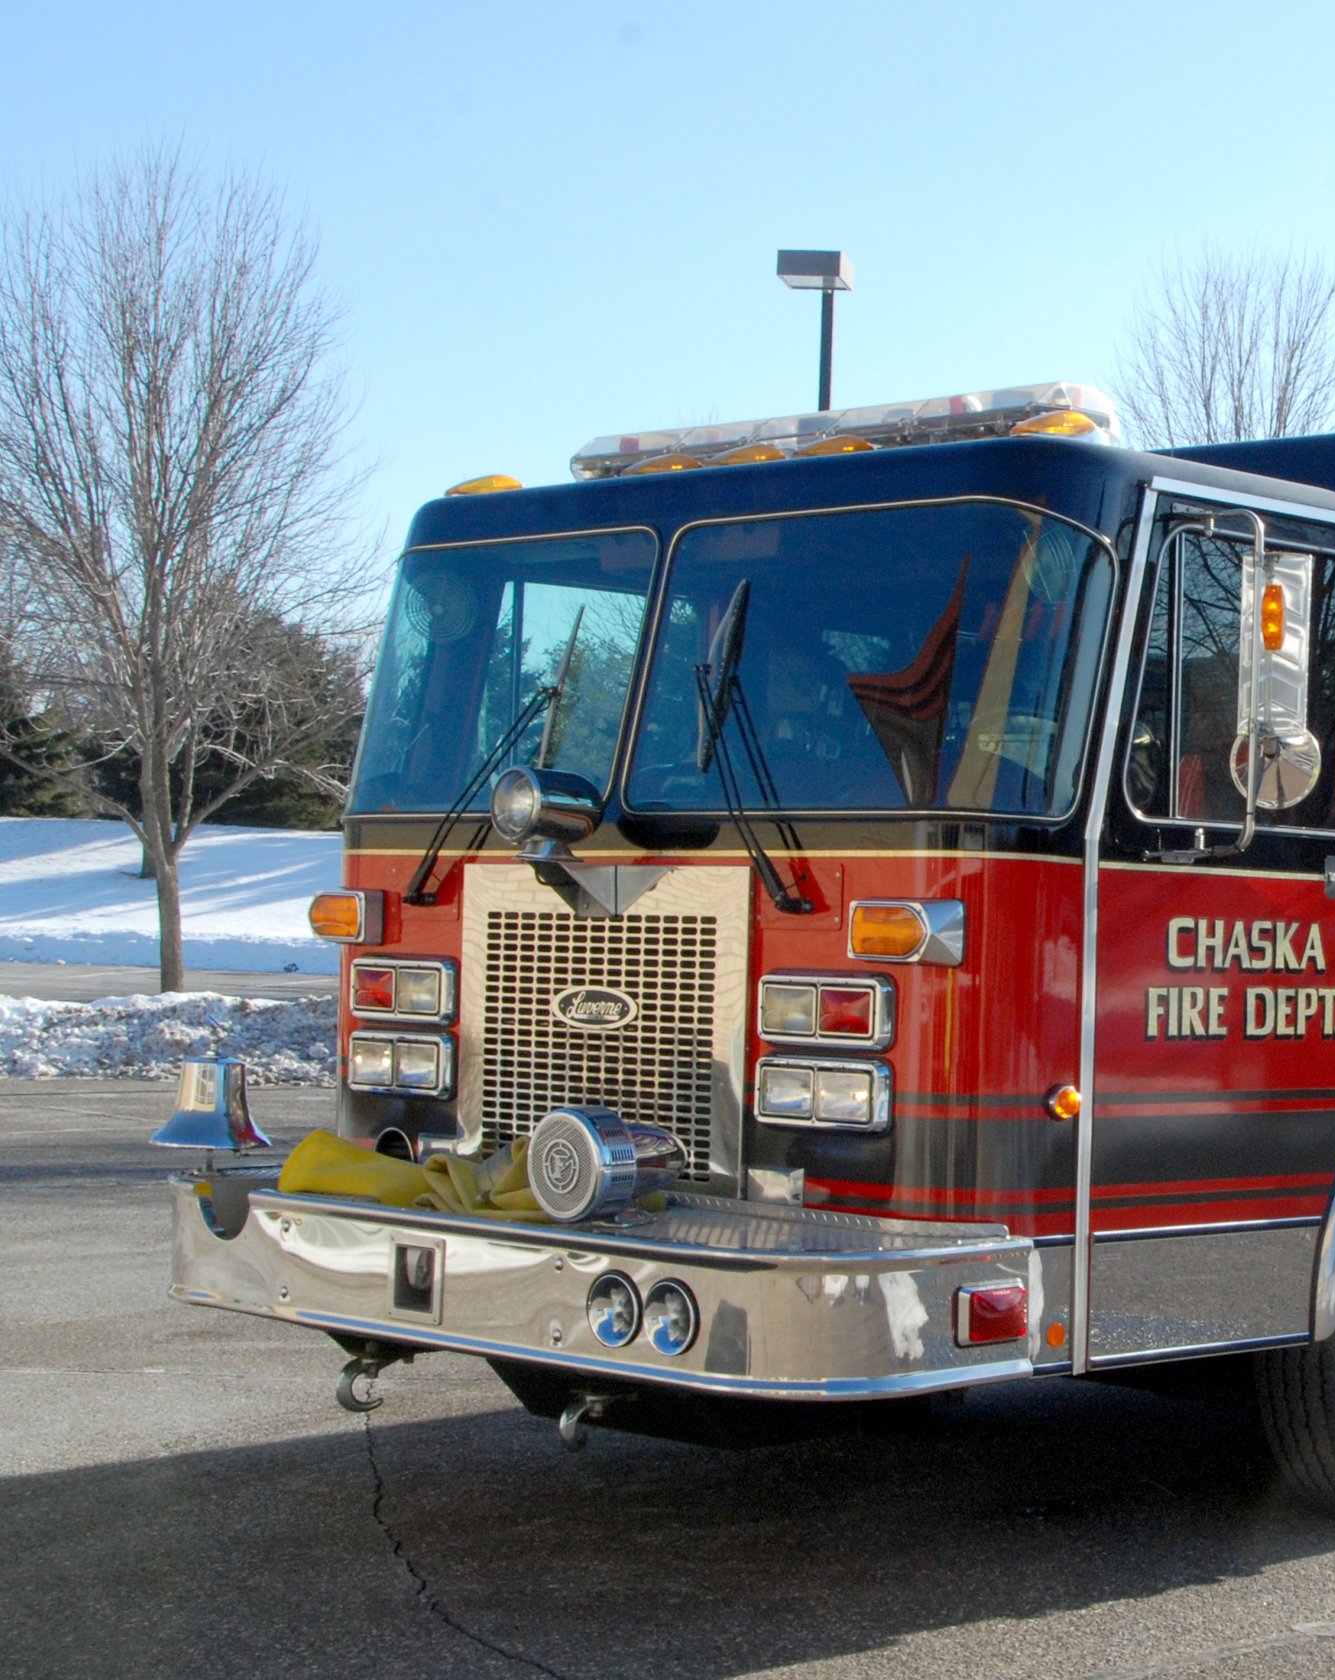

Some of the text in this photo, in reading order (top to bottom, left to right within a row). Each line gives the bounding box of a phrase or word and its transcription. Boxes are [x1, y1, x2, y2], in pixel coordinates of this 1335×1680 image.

[1168, 917, 1326, 971] CHASKA
[566, 990, 622, 1019] Luverne
[1146, 986, 1229, 1041] FIRE
